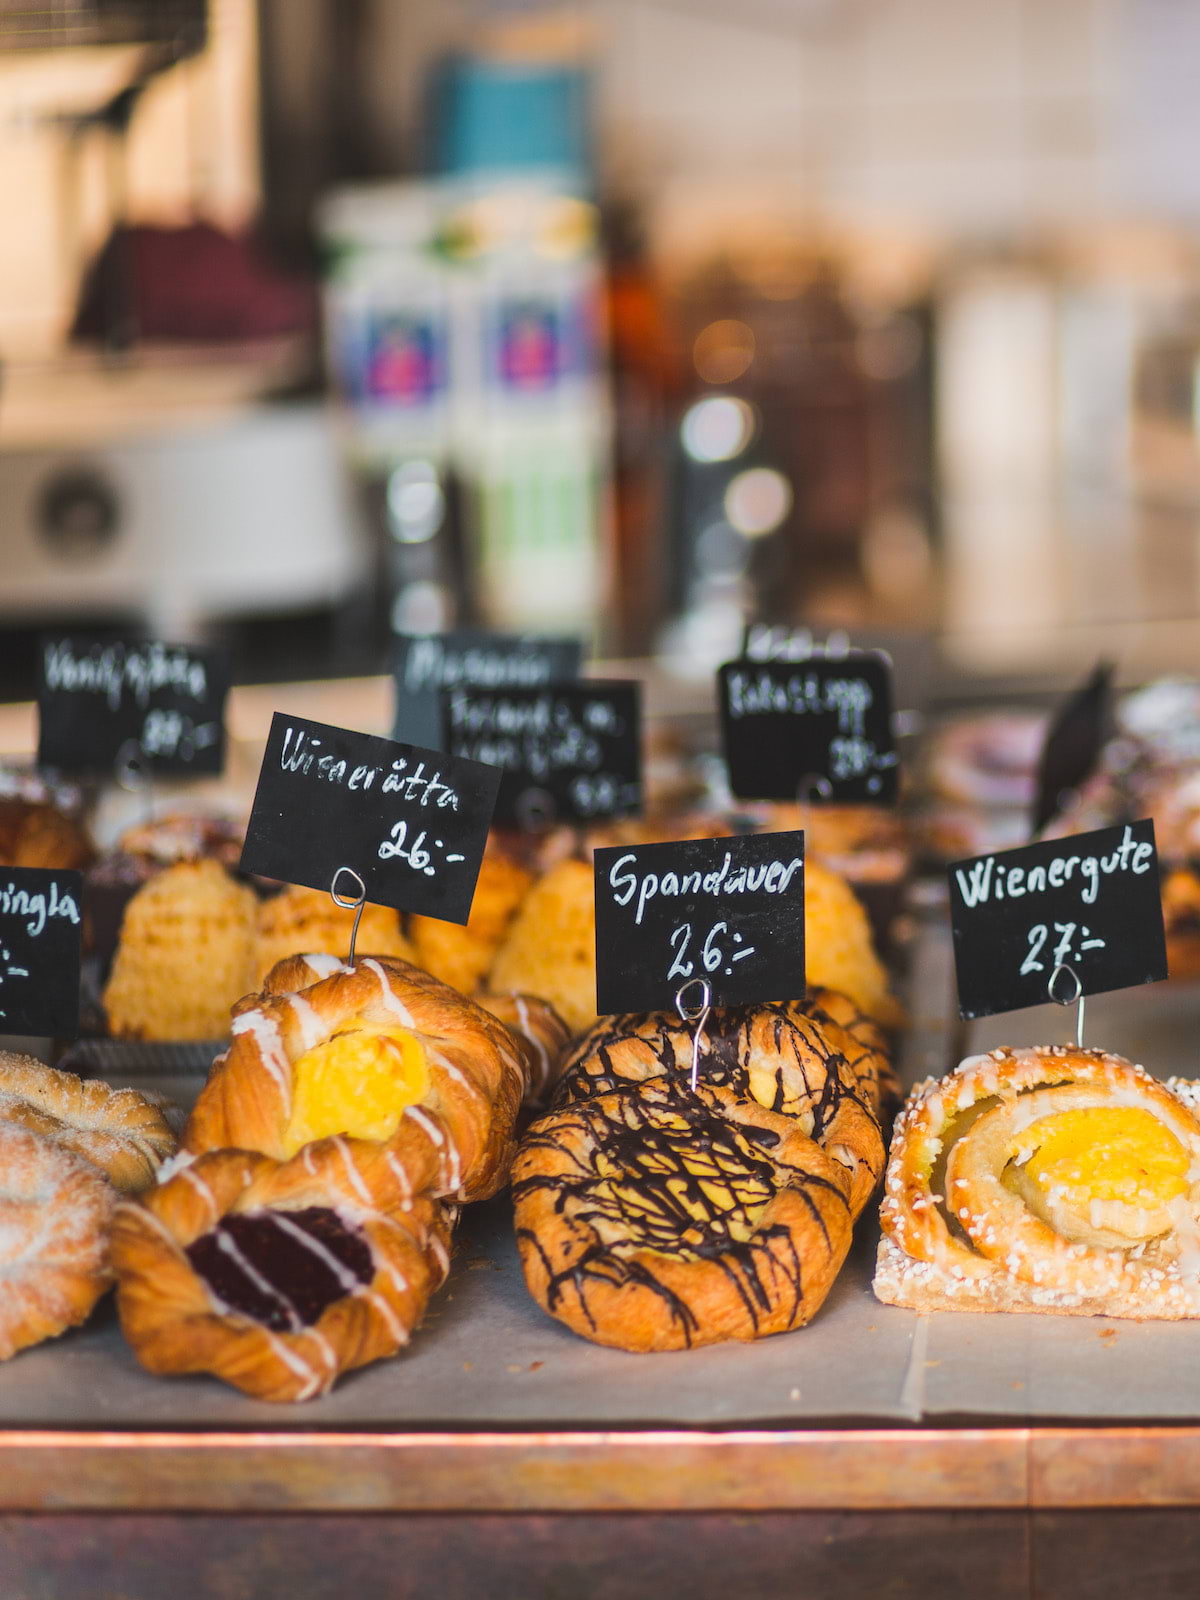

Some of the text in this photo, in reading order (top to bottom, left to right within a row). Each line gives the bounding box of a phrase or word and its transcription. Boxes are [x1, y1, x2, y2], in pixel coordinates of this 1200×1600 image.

[378, 820, 465, 876] 26:-
[956, 825, 1153, 908] Wienergute
[0, 882, 80, 936] ingla
[609, 852, 803, 925] Spandauer
[667, 921, 755, 981] 26:-
[1019, 921, 1106, 976] 27:-
